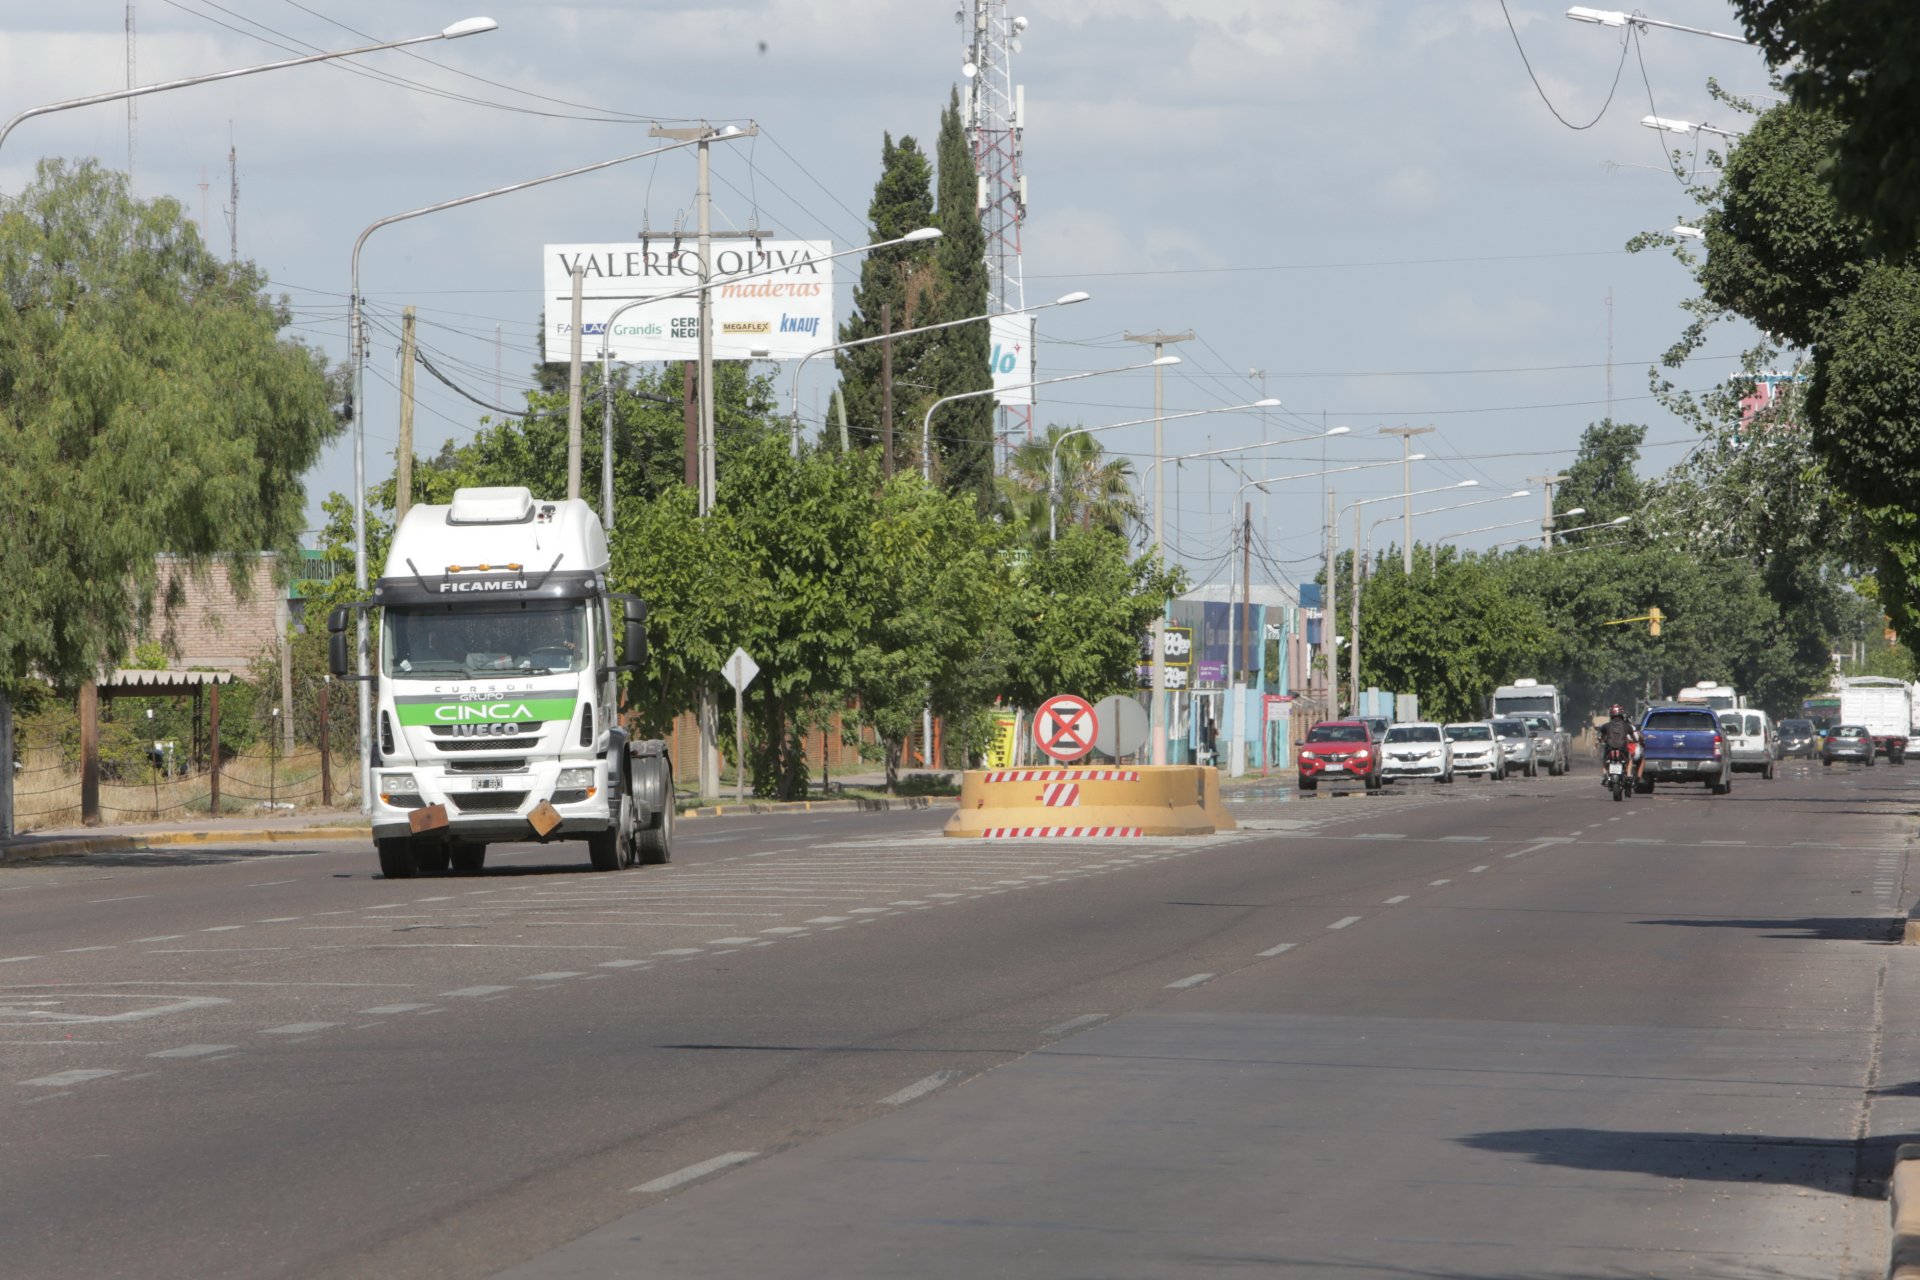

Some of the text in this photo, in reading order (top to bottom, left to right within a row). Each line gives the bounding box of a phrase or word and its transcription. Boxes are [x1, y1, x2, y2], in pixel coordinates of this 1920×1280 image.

[557, 251, 700, 278] VALERIO
[721, 279, 822, 299] maderas
[671, 317, 713, 327] CER
[723, 322, 769, 332] MEGAFLEX
[613, 323, 662, 335] Grandis
[671, 328, 713, 338] NEG
[440, 580, 528, 593] FICAMEN
[434, 683, 533, 693] CURSOR
[459, 692, 504, 702] GRUPO
[434, 703, 533, 720] CINCA
[452, 722, 519, 738] IVECO
